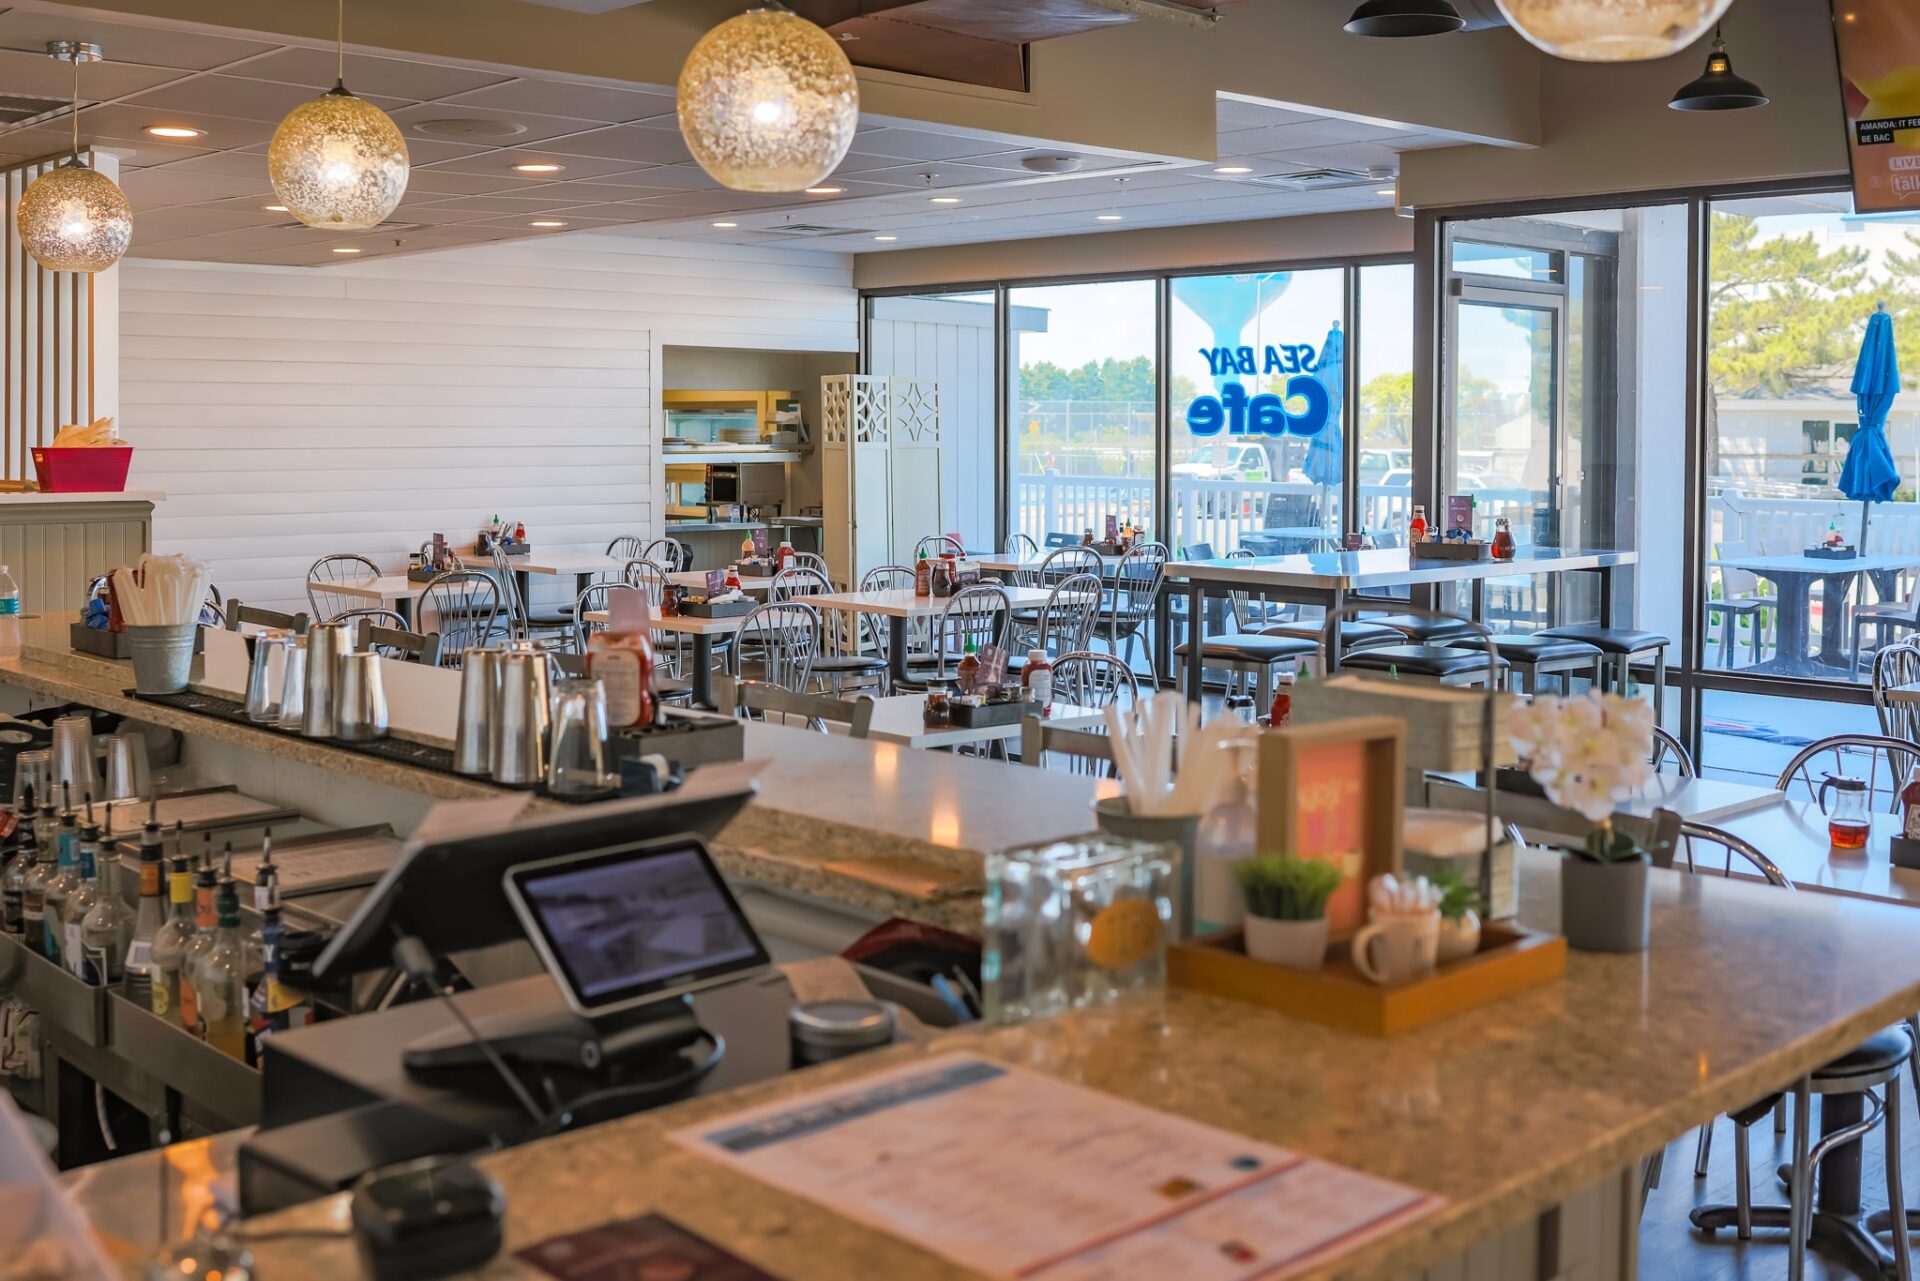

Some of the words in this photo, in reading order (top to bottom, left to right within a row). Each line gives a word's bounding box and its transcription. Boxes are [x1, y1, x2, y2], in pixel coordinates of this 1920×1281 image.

[1860, 121, 1897, 130] AMANDA:
[1899, 119, 1906, 127] IT
[1861, 135, 1872, 143] BE
[1873, 133, 1890, 142] BAC
[1893, 157, 1920, 168] LIVE
